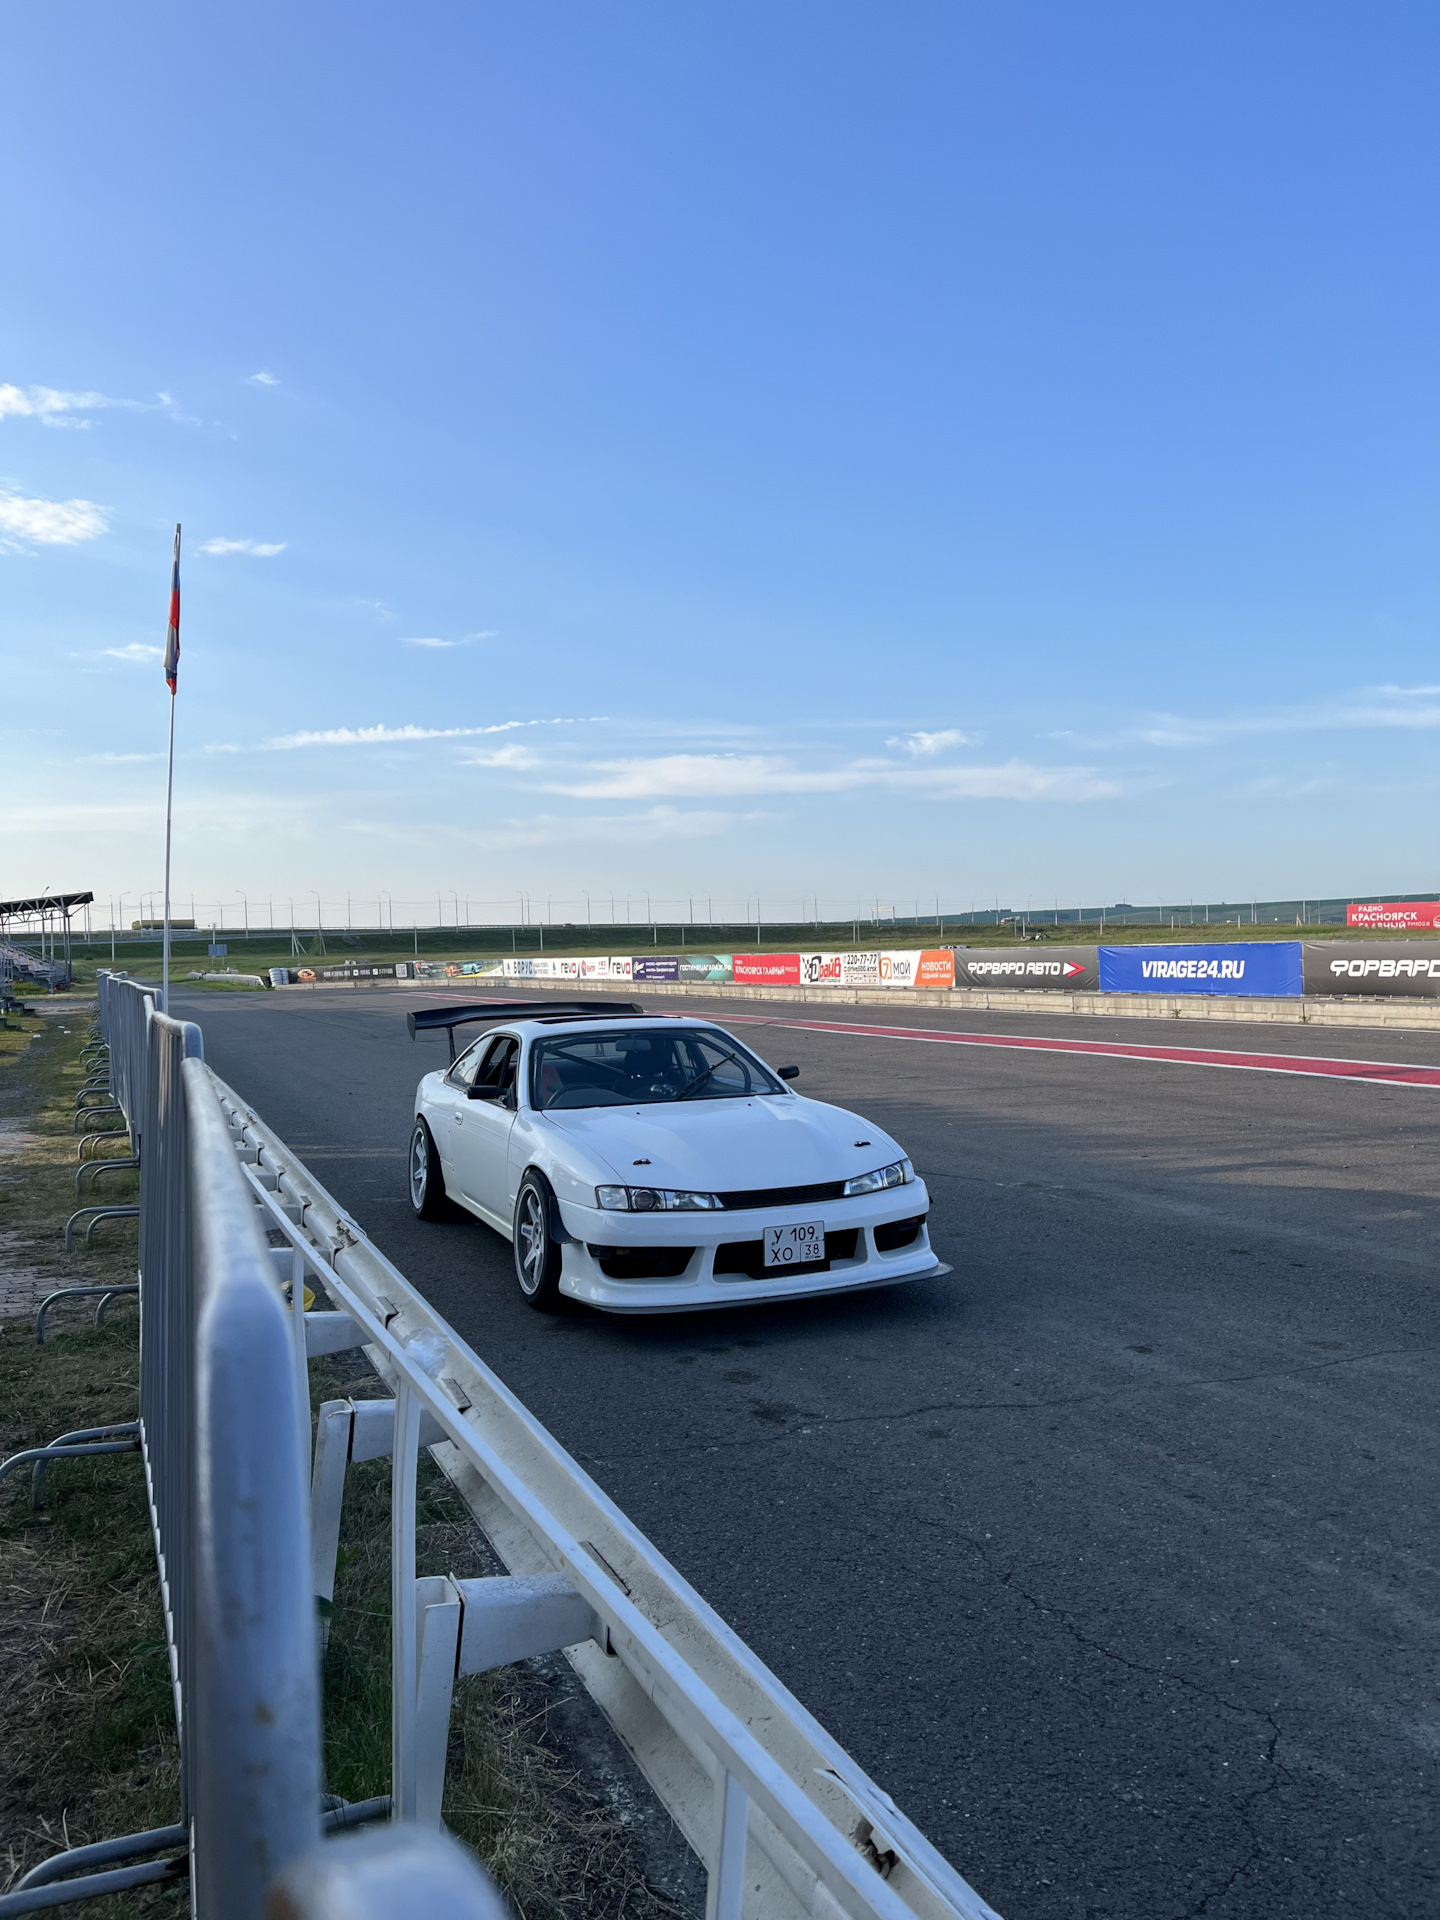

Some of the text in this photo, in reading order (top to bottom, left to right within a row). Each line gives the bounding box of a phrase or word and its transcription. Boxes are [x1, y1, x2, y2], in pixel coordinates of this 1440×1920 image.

[1351, 912, 1418, 922] КРАСНОЯРСК
[847, 954, 878, 965] 220-77-77
[893, 960, 911, 975] МОЙ
[921, 961, 952, 972] НОВОСТИ
[1025, 962, 1061, 976] АВТО
[1142, 960, 1246, 978] VIRAGE24.RU
[790, 1226, 815, 1242] 109
[805, 1243, 820, 1256] 38
